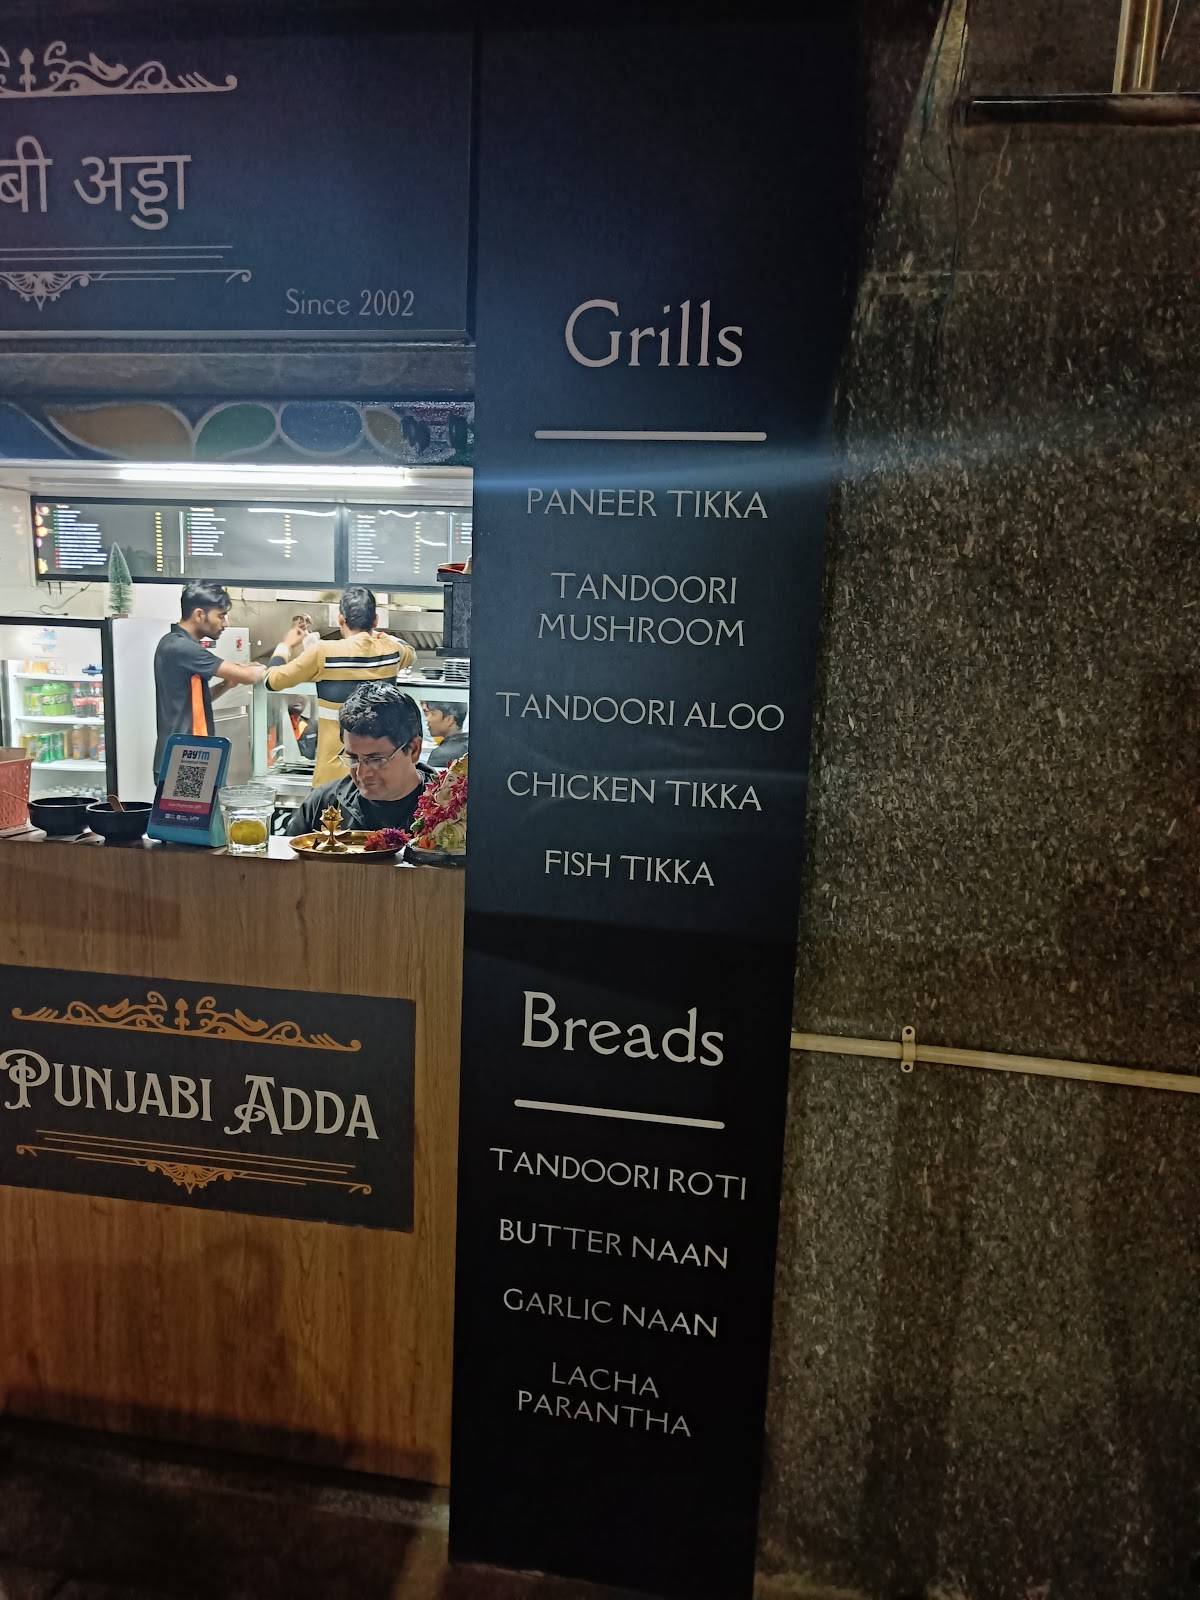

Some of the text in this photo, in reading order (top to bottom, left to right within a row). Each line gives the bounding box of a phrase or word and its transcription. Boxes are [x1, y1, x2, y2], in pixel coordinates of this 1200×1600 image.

[73, 153, 192, 231] अड्डा
[285, 288, 415, 317] Since 2002
[564, 298, 744, 368] Grills
[527, 487, 769, 519] PANEER TIKKA
[550, 572, 737, 605] TANDOORI
[537, 613, 746, 647] MUSHROOM
[495, 691, 785, 732] TANDOORI ALOO
[507, 770, 763, 811] CHICKEN TIKKA
[544, 849, 715, 887] FISH TIKKA
[521, 990, 725, 1067] Breads
[0, 1048, 380, 1140] PUNJABI ADDA
[489, 1147, 747, 1201] TANDOORI ROTI
[499, 1218, 729, 1270] BUTTER NAAN
[503, 1287, 718, 1339] GARLIC NAAN
[551, 1361, 660, 1399] LACHA
[517, 1389, 692, 1438] PARANTHA
